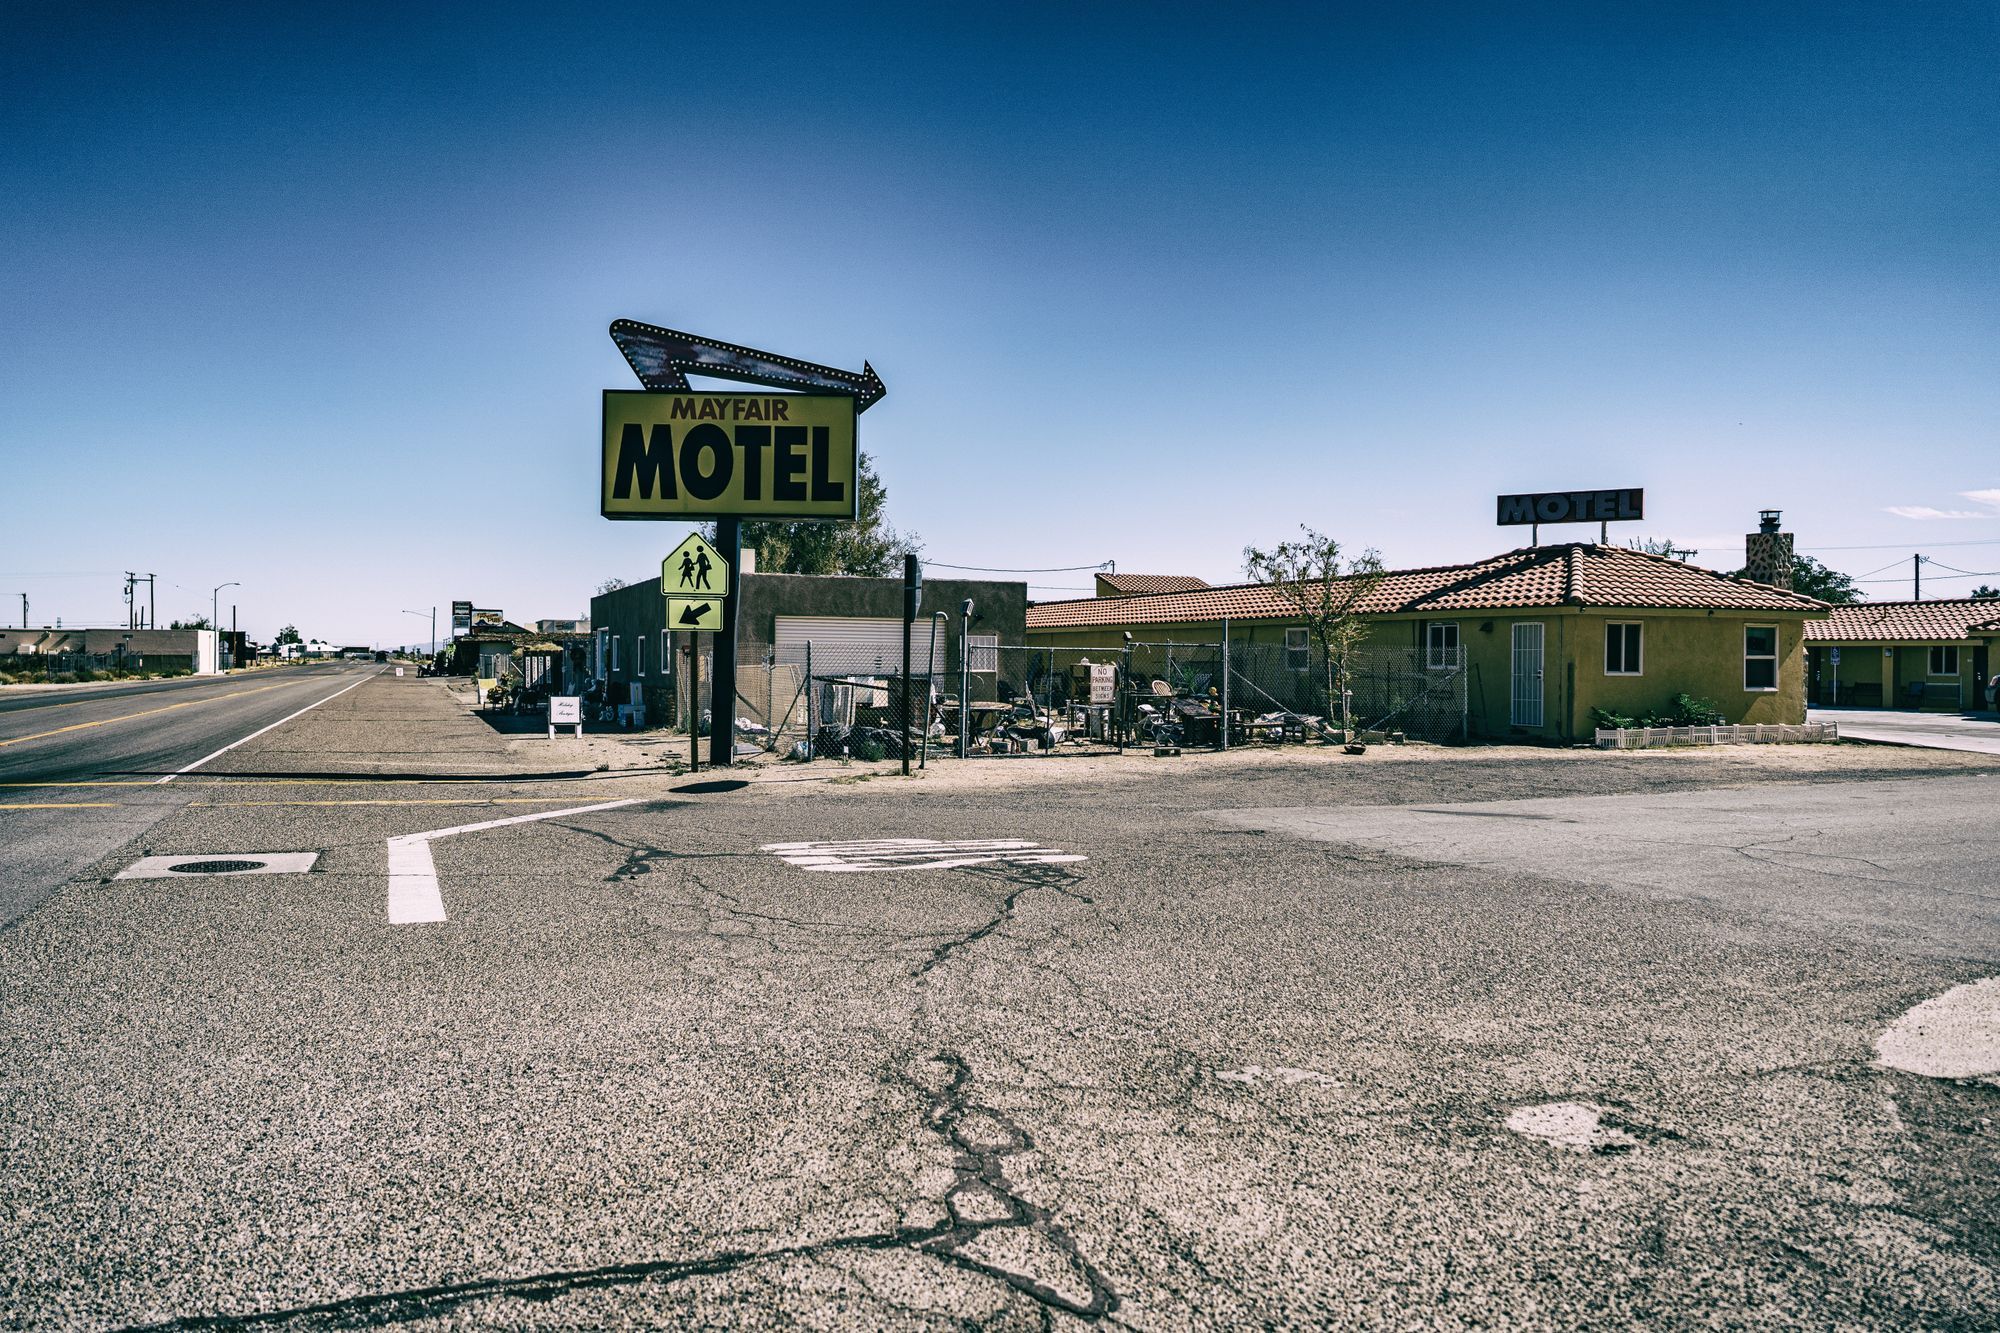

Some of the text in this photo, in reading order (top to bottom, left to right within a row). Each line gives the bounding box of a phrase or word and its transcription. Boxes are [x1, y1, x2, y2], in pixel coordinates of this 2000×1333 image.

[670, 397, 789, 421] MAYFAIR
[612, 423, 844, 501] MOTEL
[1500, 490, 1640, 522] MOTEL
[1097, 668, 1108, 676] NO
[760, 838, 1089, 872] STOP
